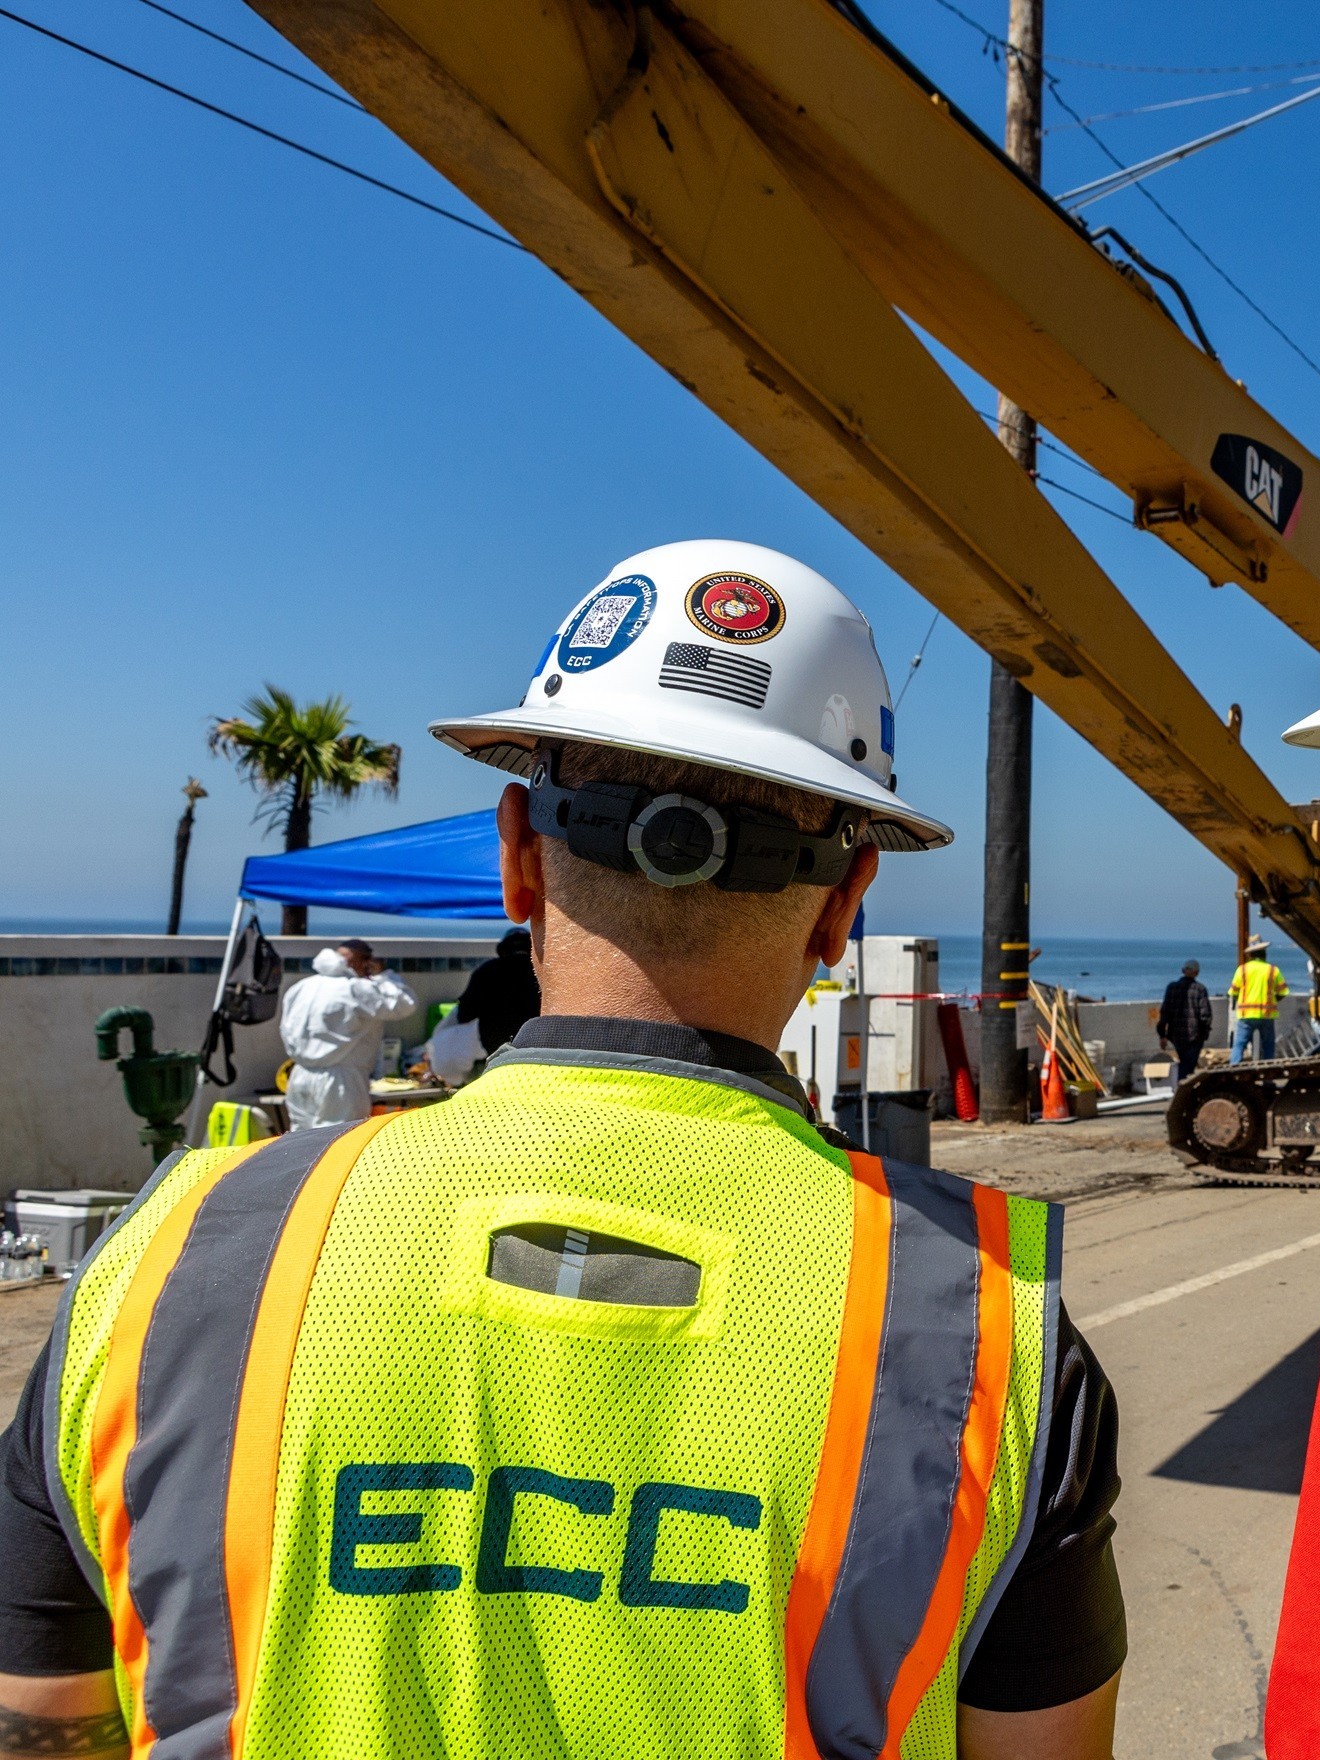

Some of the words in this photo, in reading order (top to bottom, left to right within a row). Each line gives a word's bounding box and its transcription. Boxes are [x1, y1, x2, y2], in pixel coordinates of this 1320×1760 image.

[1245, 445, 1283, 524] CAT
[627, 577, 653, 638] INFORMATION
[706, 576, 746, 586] UNITED
[748, 580, 777, 604] STATES
[693, 606, 727, 636] MARINE
[734, 625, 770, 638] CORPS
[566, 655, 593, 667] ECC
[328, 1461, 764, 1615] ECC
